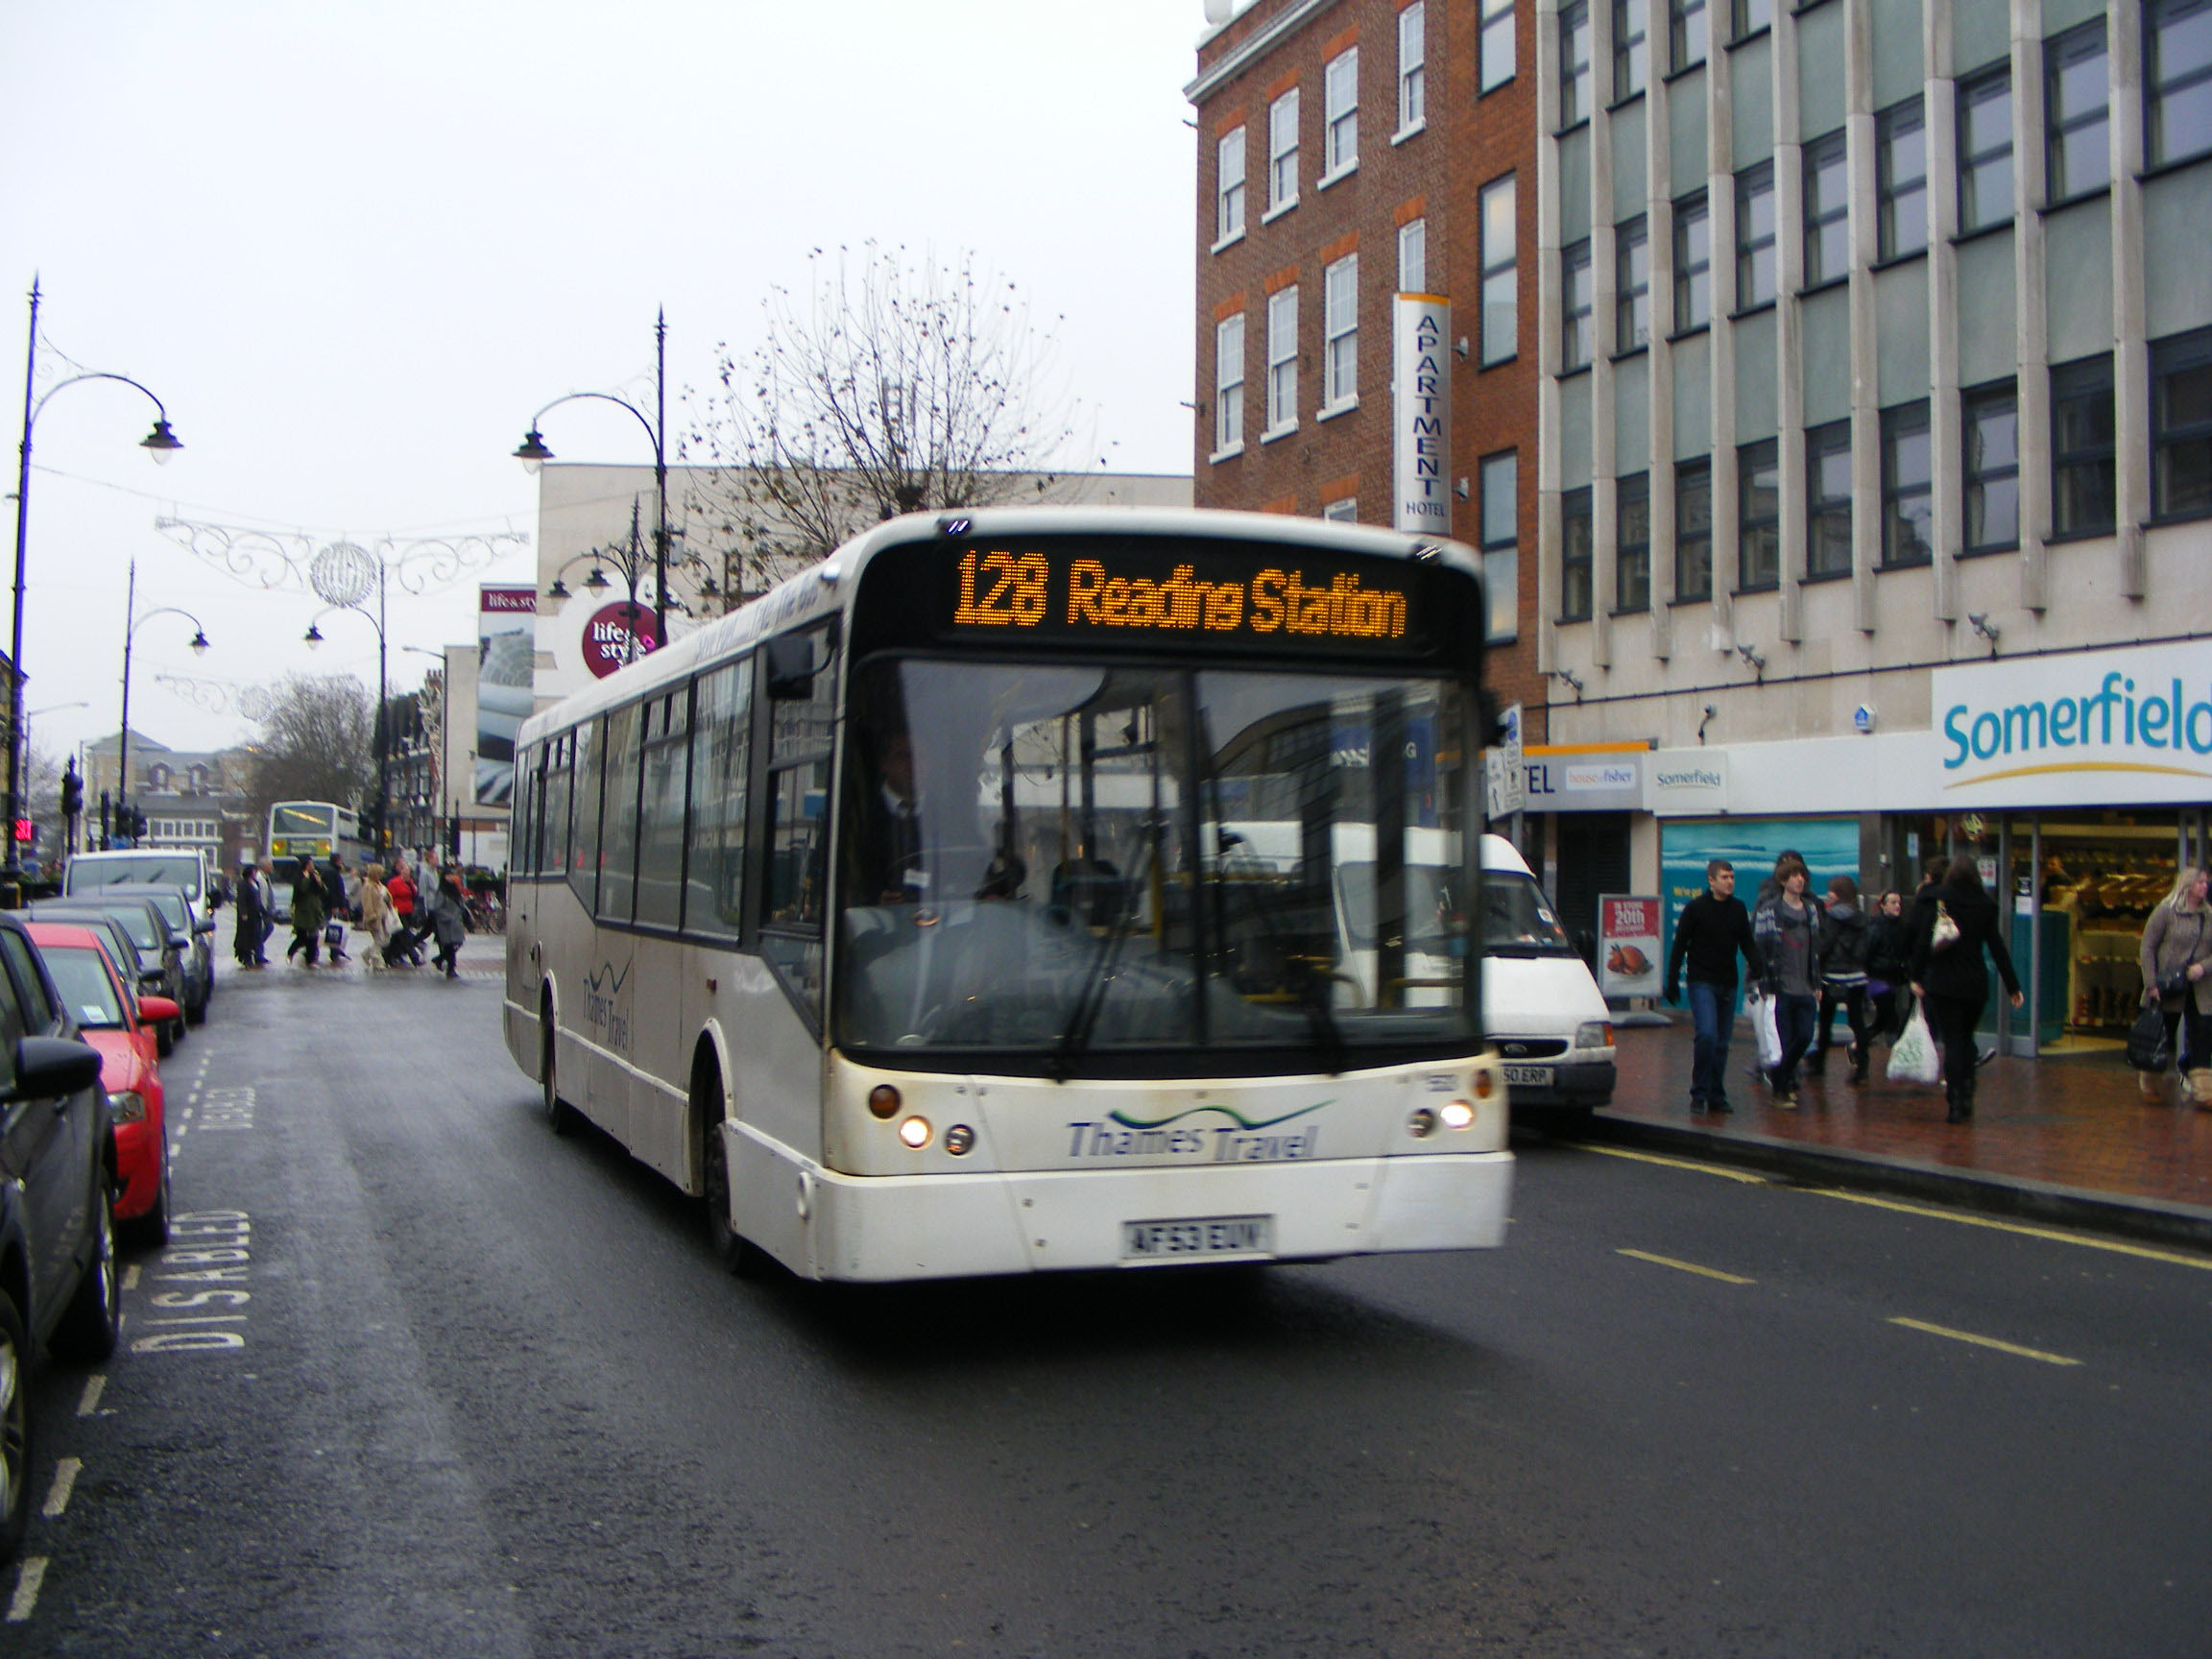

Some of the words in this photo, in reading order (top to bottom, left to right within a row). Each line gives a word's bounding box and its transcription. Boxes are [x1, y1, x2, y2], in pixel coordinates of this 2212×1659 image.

[1413, 315, 1441, 496] APARTMENT
[1406, 501, 1445, 517] HOTEL
[954, 550, 1048, 626] 128
[1068, 559, 1244, 630] Reading
[1250, 568, 1407, 637] Station
[1657, 769, 1721, 787] Somerfield
[1067, 1121, 1205, 1158] Thames
[1211, 1125, 1318, 1162] Travel
